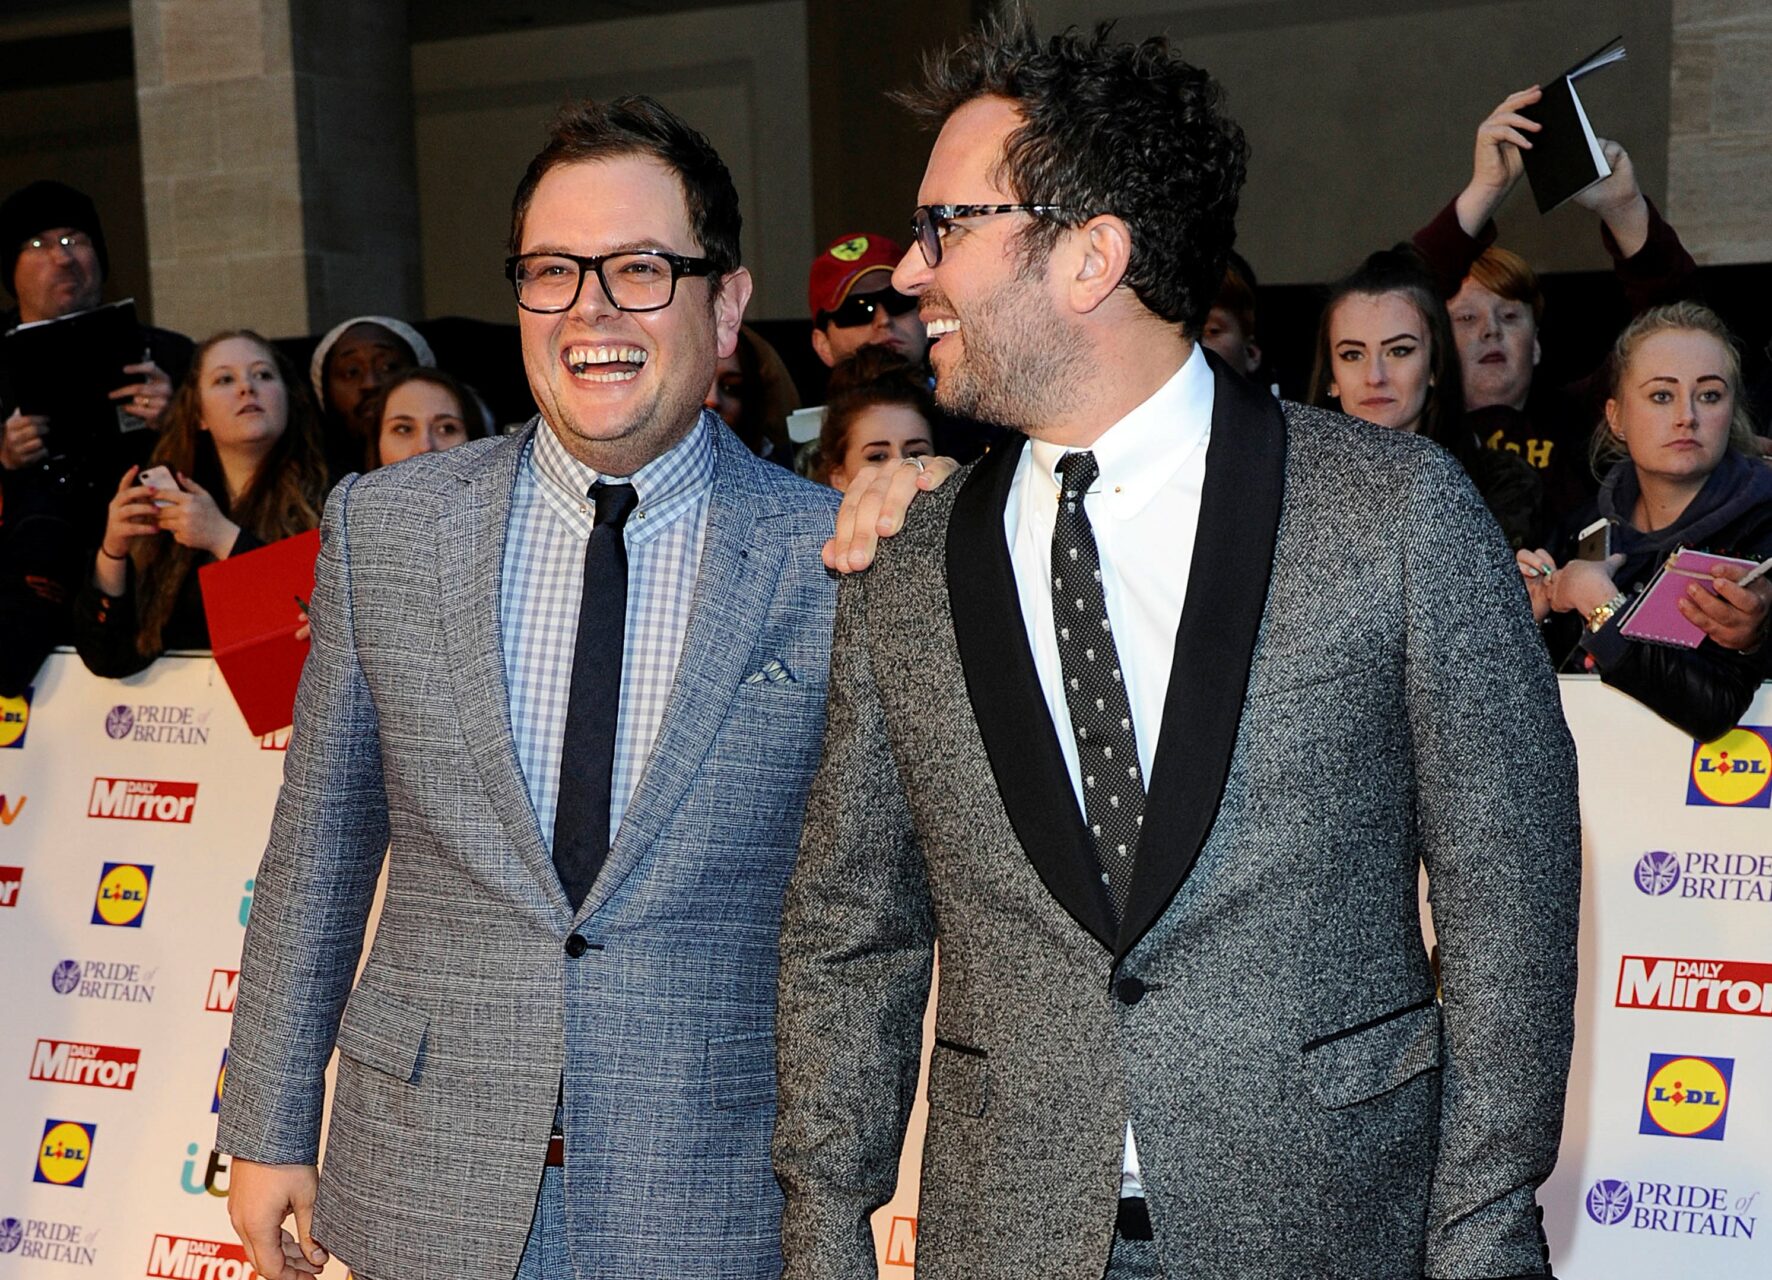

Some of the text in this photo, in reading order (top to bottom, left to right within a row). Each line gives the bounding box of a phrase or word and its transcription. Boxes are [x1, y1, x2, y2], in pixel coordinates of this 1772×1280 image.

[136, 705, 194, 725] PRIDE
[133, 724, 210, 746] BRITAIN
[128, 782, 158, 794] DAILY
[91, 780, 196, 821] Mirror
[1684, 852, 1772, 877] PRIDE
[83, 960, 140, 982] PRIDE
[1675, 961, 1724, 978] DAILY
[78, 980, 155, 1003] BRITAIN
[69, 1044, 101, 1059] DAILY
[32, 1041, 137, 1087] Mirror
[1635, 1181, 1760, 1216] PRIDE of
[25, 1219, 82, 1243] PRIDE
[1631, 1206, 1757, 1239] BRITAIN
[20, 1239, 97, 1265] BRITAIN
[189, 1240, 221, 1257] DAILY
